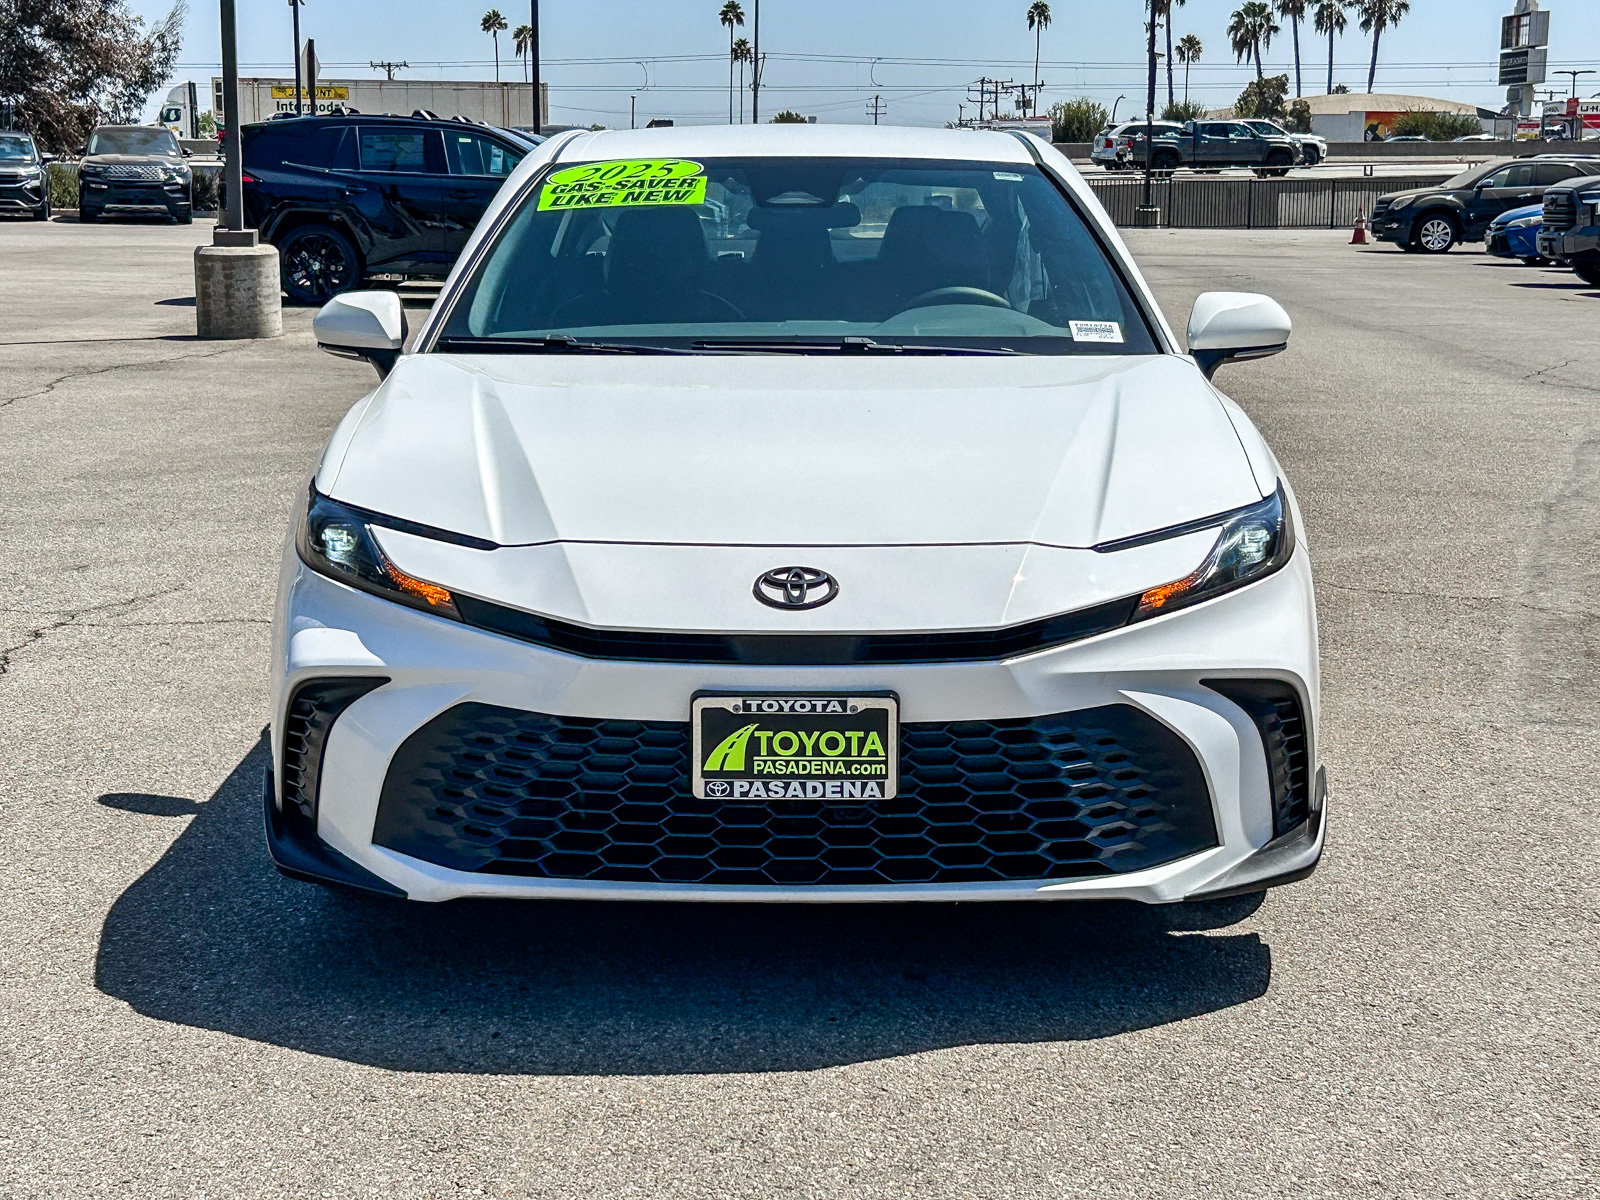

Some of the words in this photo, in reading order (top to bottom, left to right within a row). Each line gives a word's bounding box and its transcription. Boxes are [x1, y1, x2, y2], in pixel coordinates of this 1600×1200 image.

[573, 160, 680, 183] 2025
[549, 177, 700, 196] GAS-SAVER
[548, 192, 616, 209] LIKE
[620, 189, 695, 205] NEW
[746, 700, 843, 713] TOYOTA
[754, 730, 886, 756] TOYOTA
[754, 760, 886, 775] PASADENA.com
[733, 781, 882, 798] PASADENA
